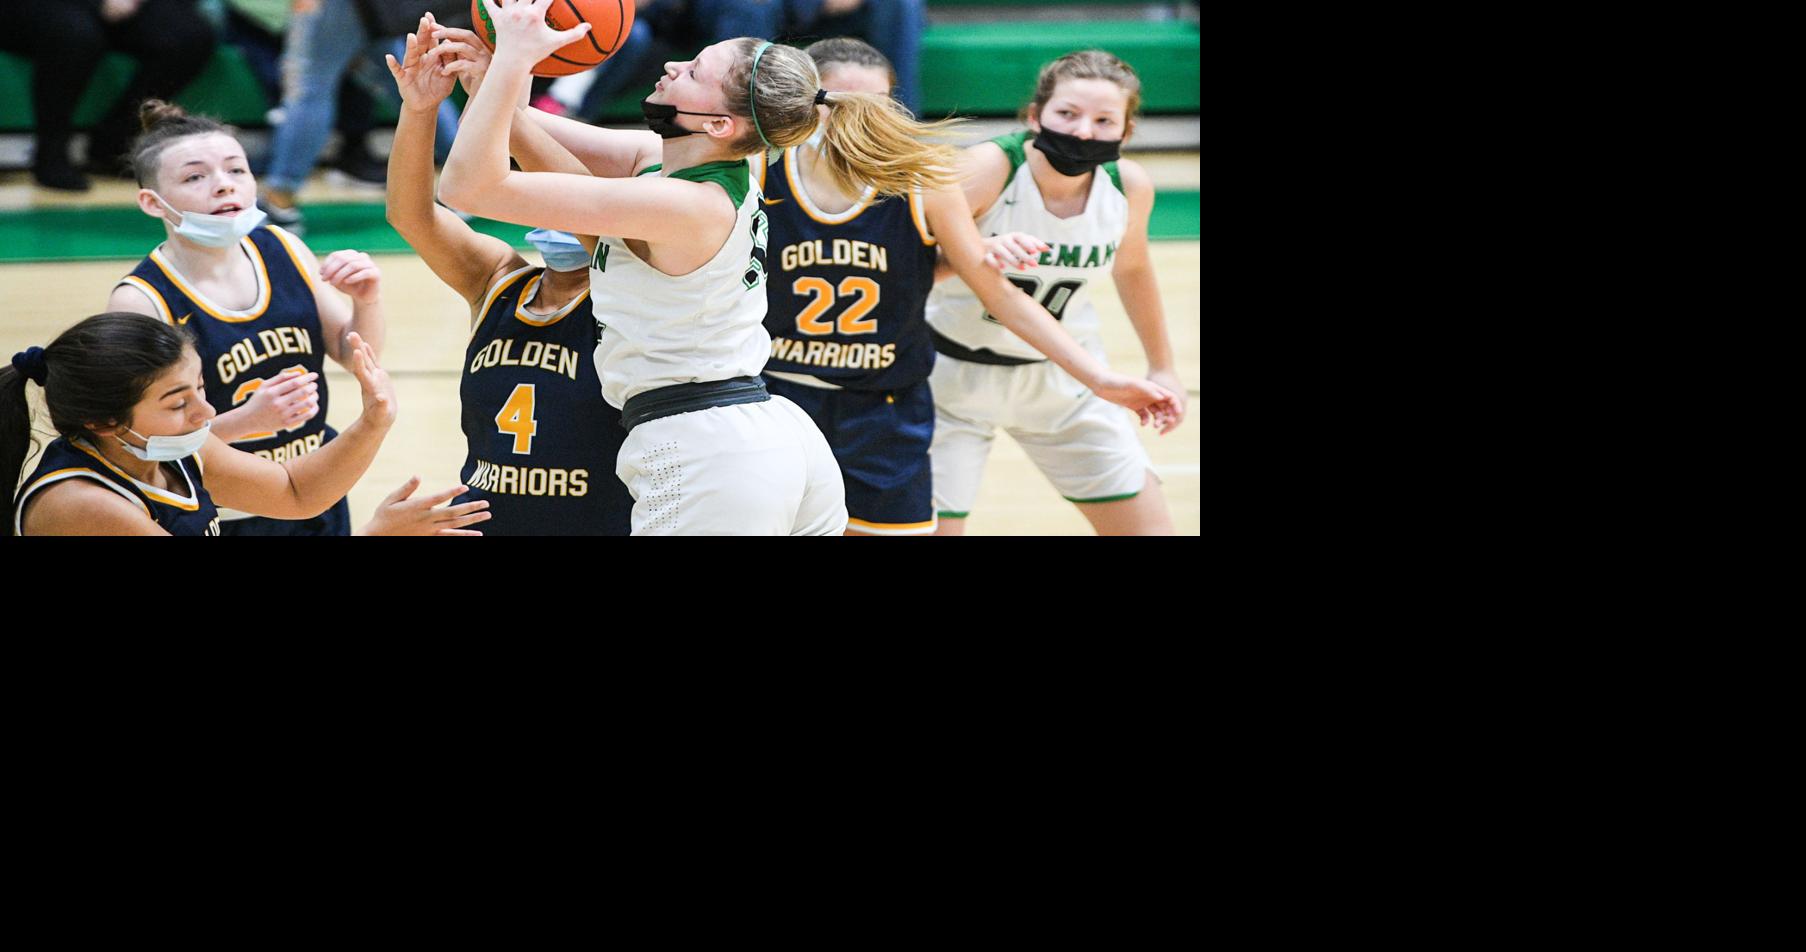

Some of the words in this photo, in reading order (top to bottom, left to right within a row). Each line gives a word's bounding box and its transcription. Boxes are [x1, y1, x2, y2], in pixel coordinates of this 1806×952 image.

[781, 239, 888, 273] GOLDEN
[1037, 240, 1116, 268] EMAN
[793, 276, 881, 336] 22
[217, 327, 313, 385] GOLDEN
[470, 339, 579, 381] GOLDEN
[770, 337, 896, 369] WARRIORS
[495, 383, 537, 455] 4
[467, 459, 589, 497] WARRIORS
